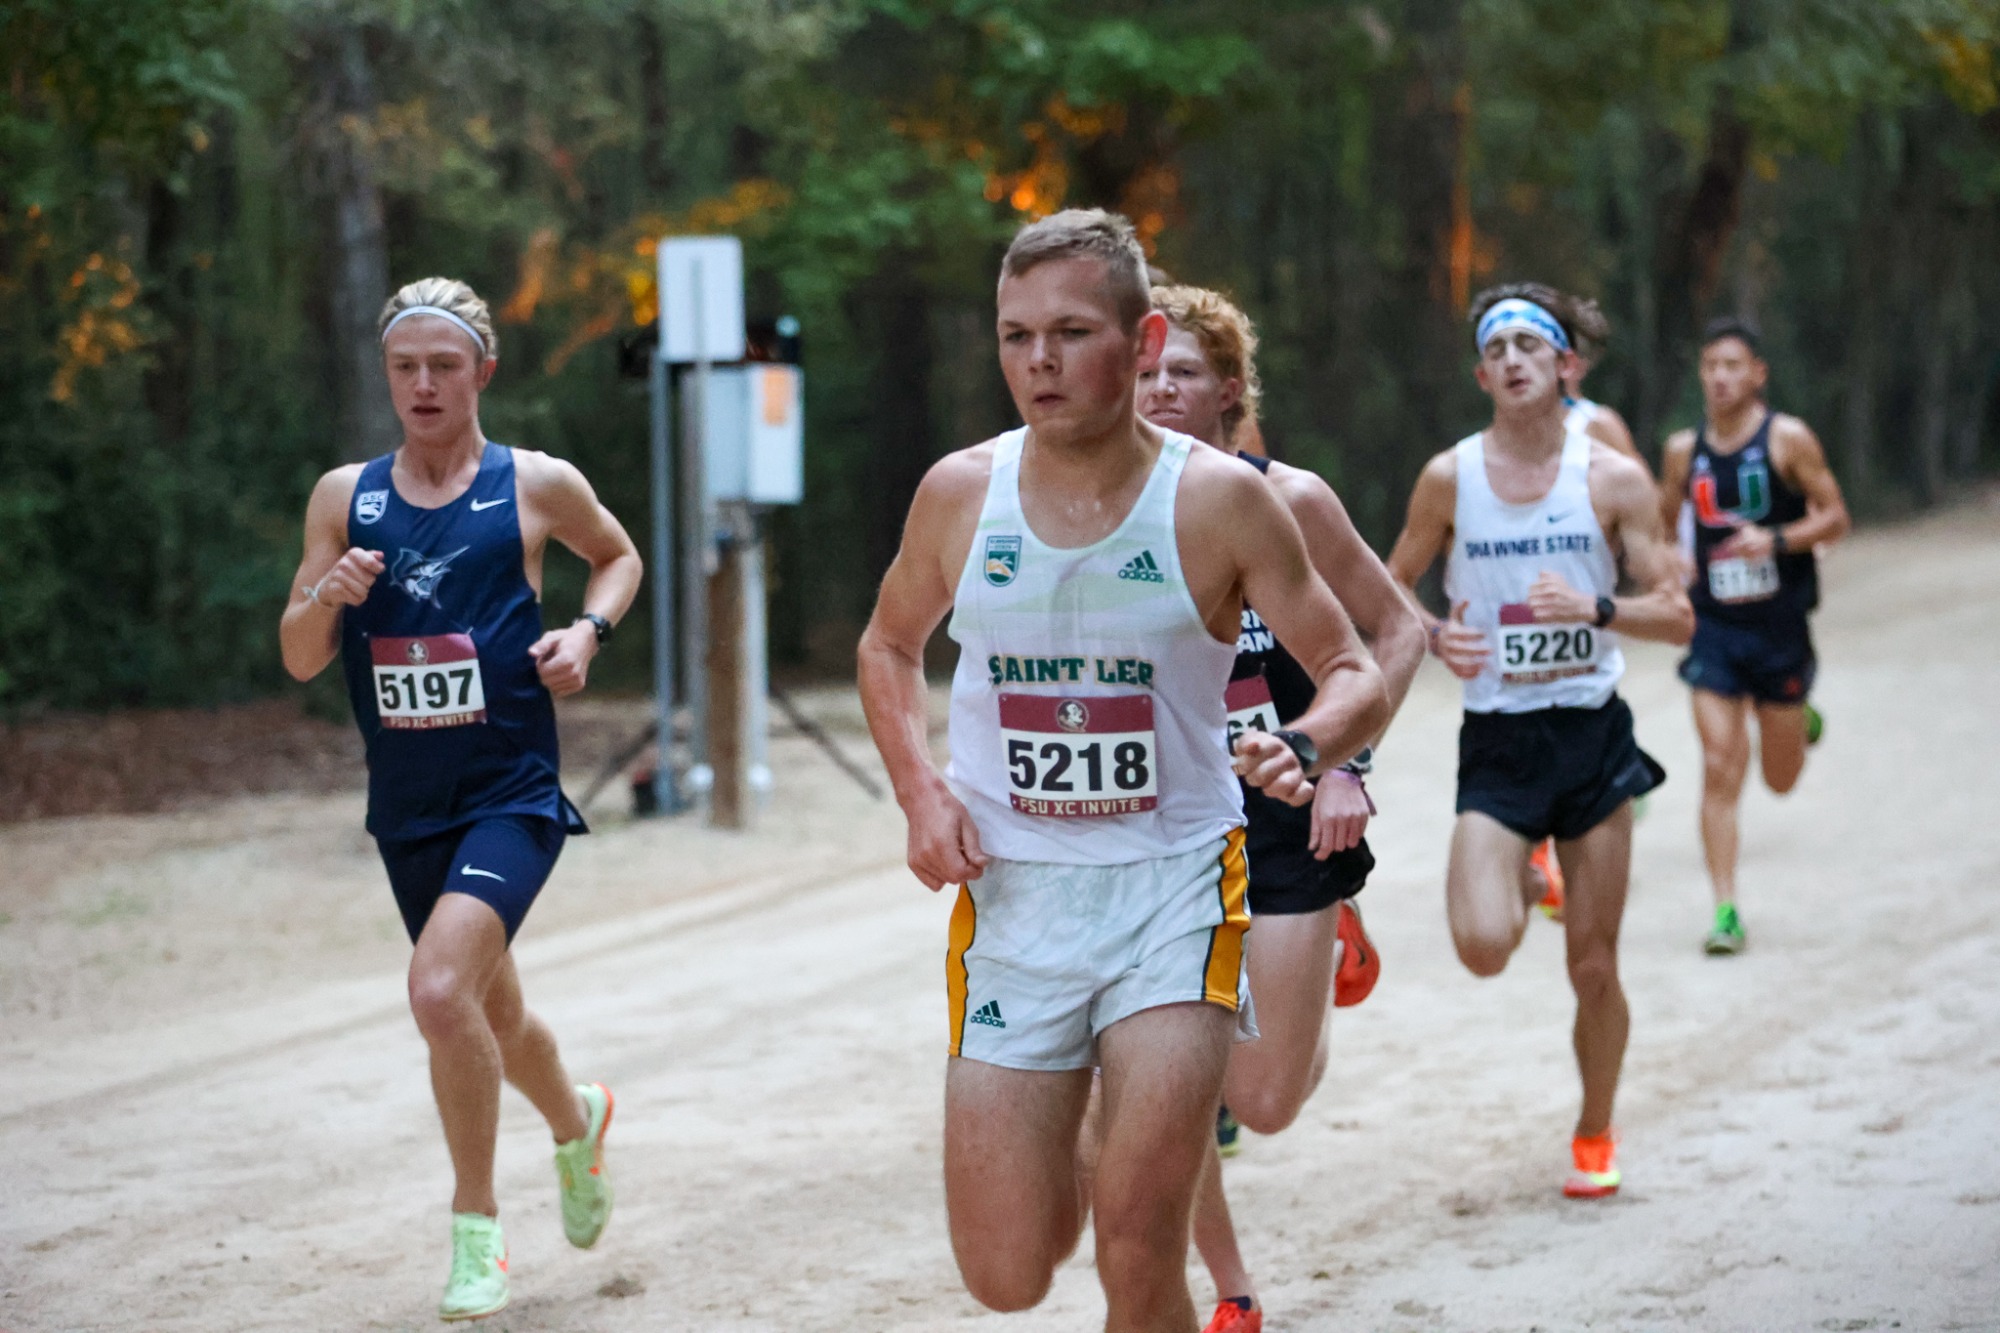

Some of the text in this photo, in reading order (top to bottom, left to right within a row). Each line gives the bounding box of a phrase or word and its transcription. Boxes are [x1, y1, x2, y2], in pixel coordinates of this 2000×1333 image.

[1545, 534, 1591, 554] STATE
[1118, 568, 1165, 584] adidas
[1505, 628, 1593, 665] 5220
[987, 654, 1087, 687] SAINT
[379, 668, 474, 710] 5197
[431, 711, 474, 728] INVITE
[1008, 739, 1149, 792] 5218
[1020, 798, 1141, 815] FSU XC INVITE
[970, 1013, 1007, 1029] adidas
